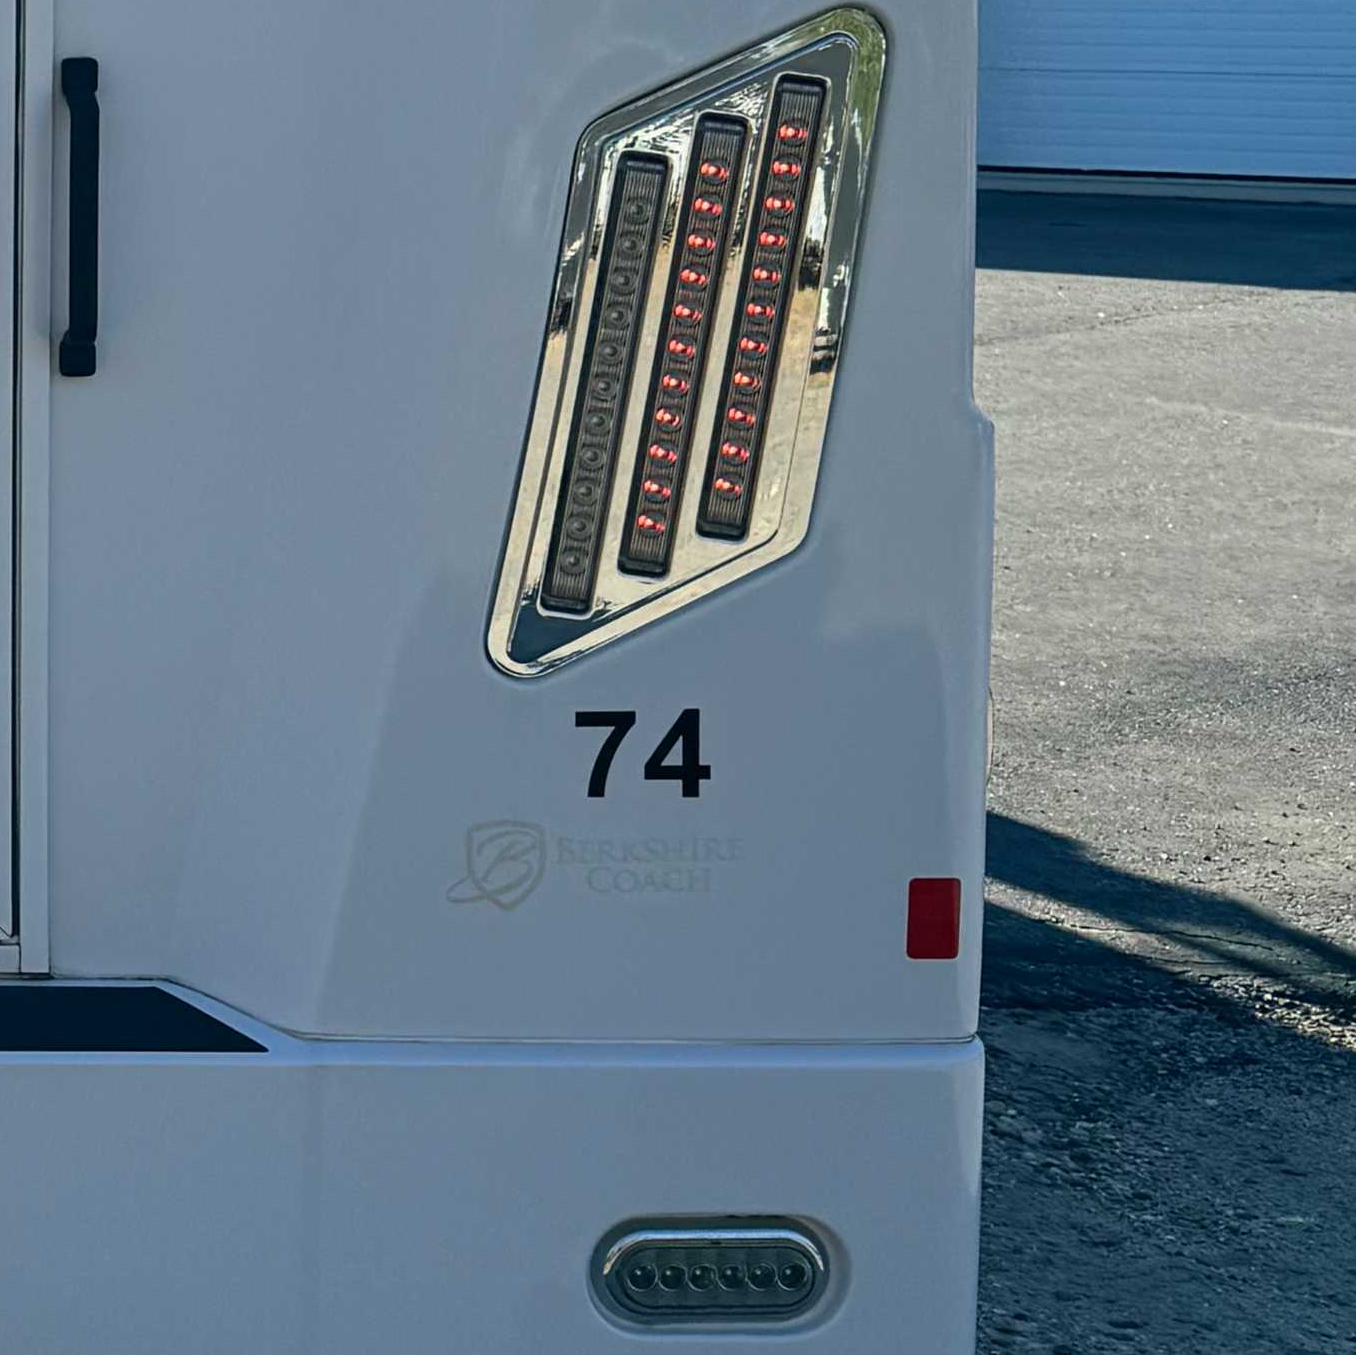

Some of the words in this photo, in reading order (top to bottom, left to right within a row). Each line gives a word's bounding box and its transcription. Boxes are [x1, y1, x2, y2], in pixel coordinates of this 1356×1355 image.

[574, 707, 712, 798] 74
[554, 834, 744, 865] BERKSHIRE
[586, 866, 713, 894] COACH
